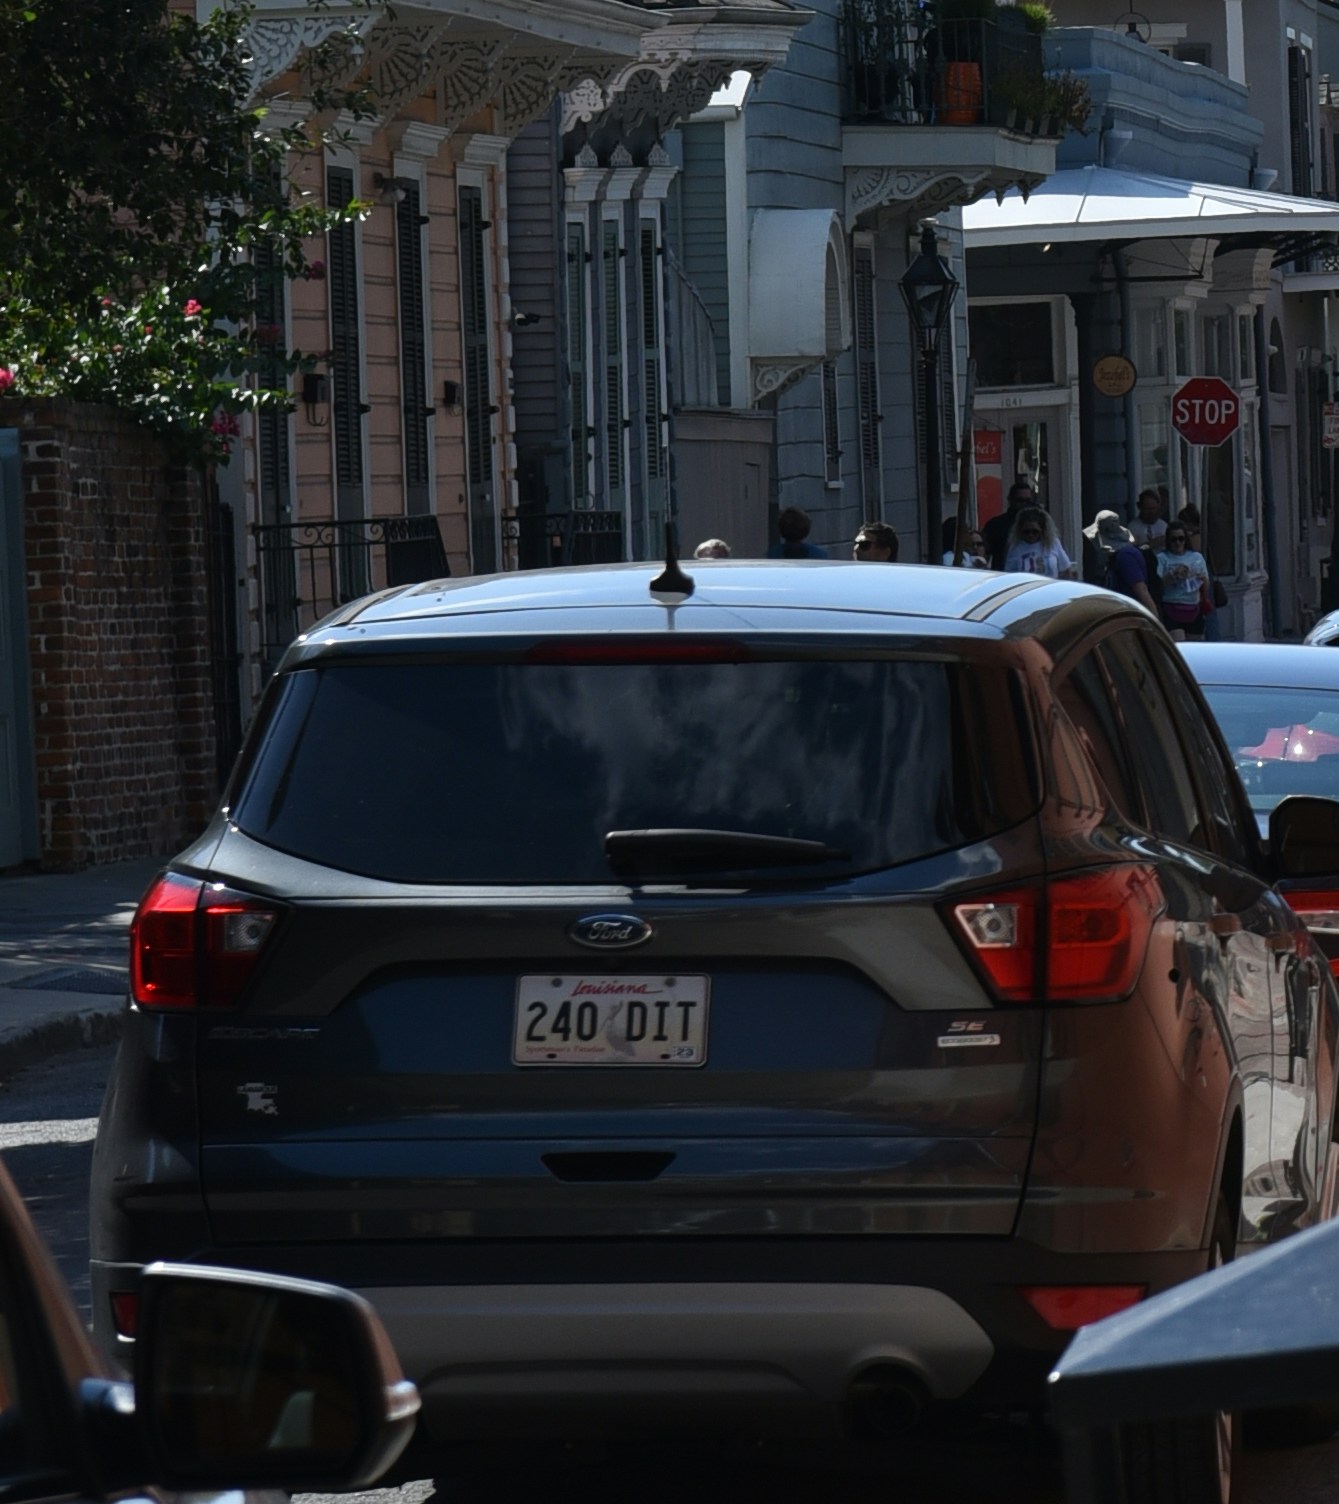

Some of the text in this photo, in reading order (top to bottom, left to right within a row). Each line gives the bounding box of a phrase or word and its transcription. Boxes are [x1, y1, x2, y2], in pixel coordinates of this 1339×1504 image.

[1000, 398, 1022, 408] 1041
[1175, 398, 1236, 426] STOP
[588, 921, 634, 940] Ford
[570, 979, 662, 996] Louisiana
[526, 1000, 697, 1042] 240 DIT
